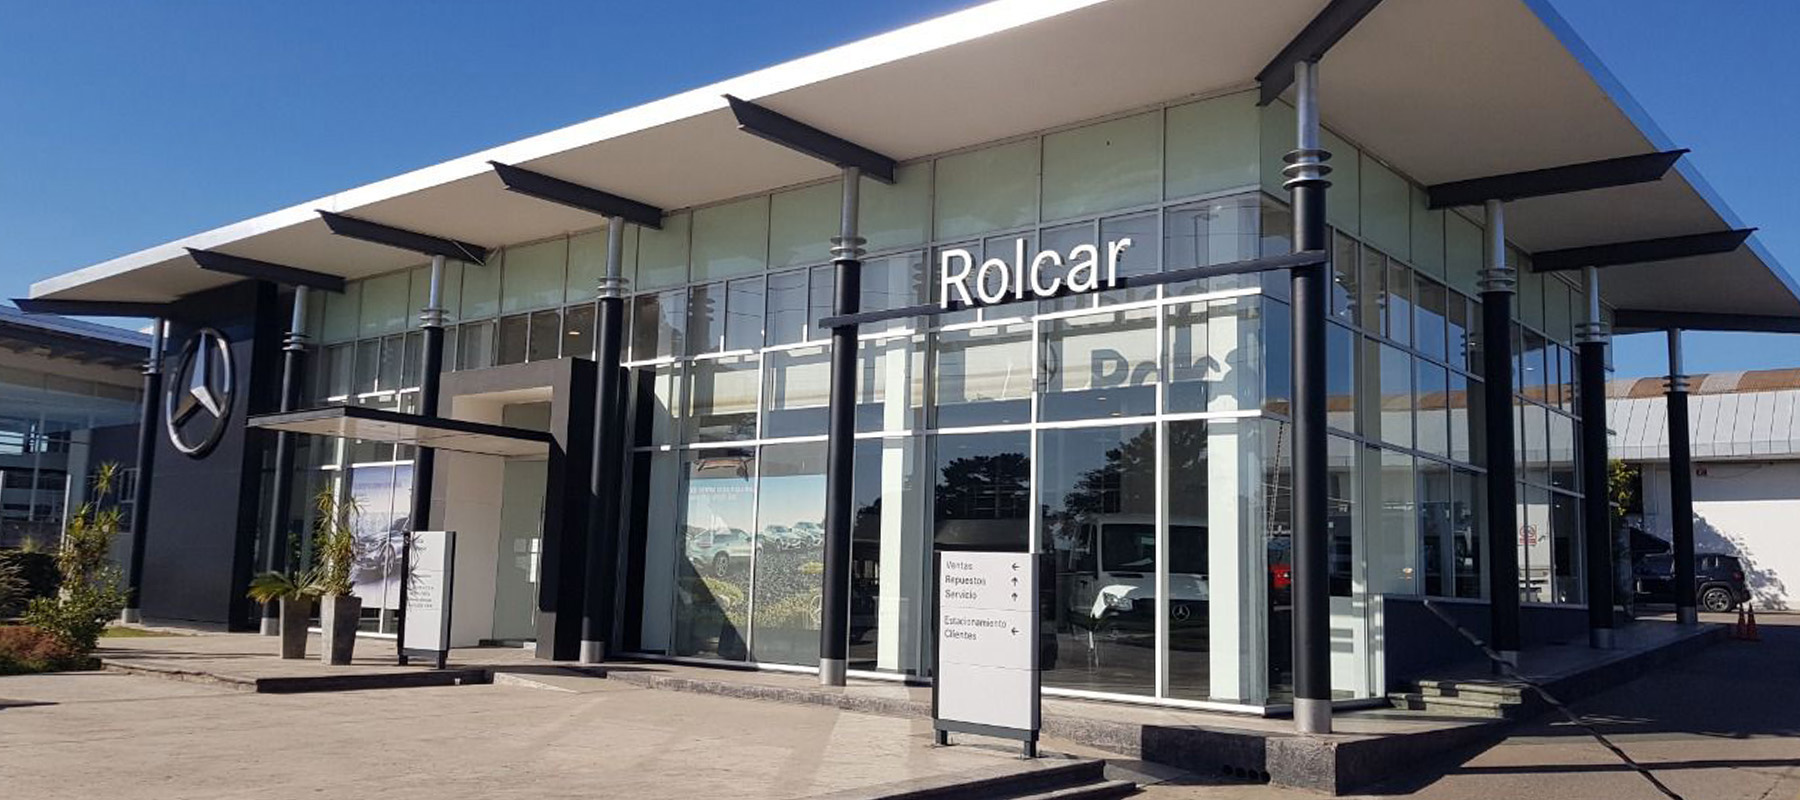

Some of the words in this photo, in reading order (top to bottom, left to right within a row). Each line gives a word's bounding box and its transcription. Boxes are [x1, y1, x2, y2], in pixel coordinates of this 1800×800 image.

[940, 238, 1131, 309] Rolcar
[946, 561, 973, 570] Ventas
[945, 575, 986, 586] Repuestos
[945, 590, 977, 600] Servicio
[944, 615, 1007, 628] Estacionamiento
[944, 630, 977, 640] Clientes
